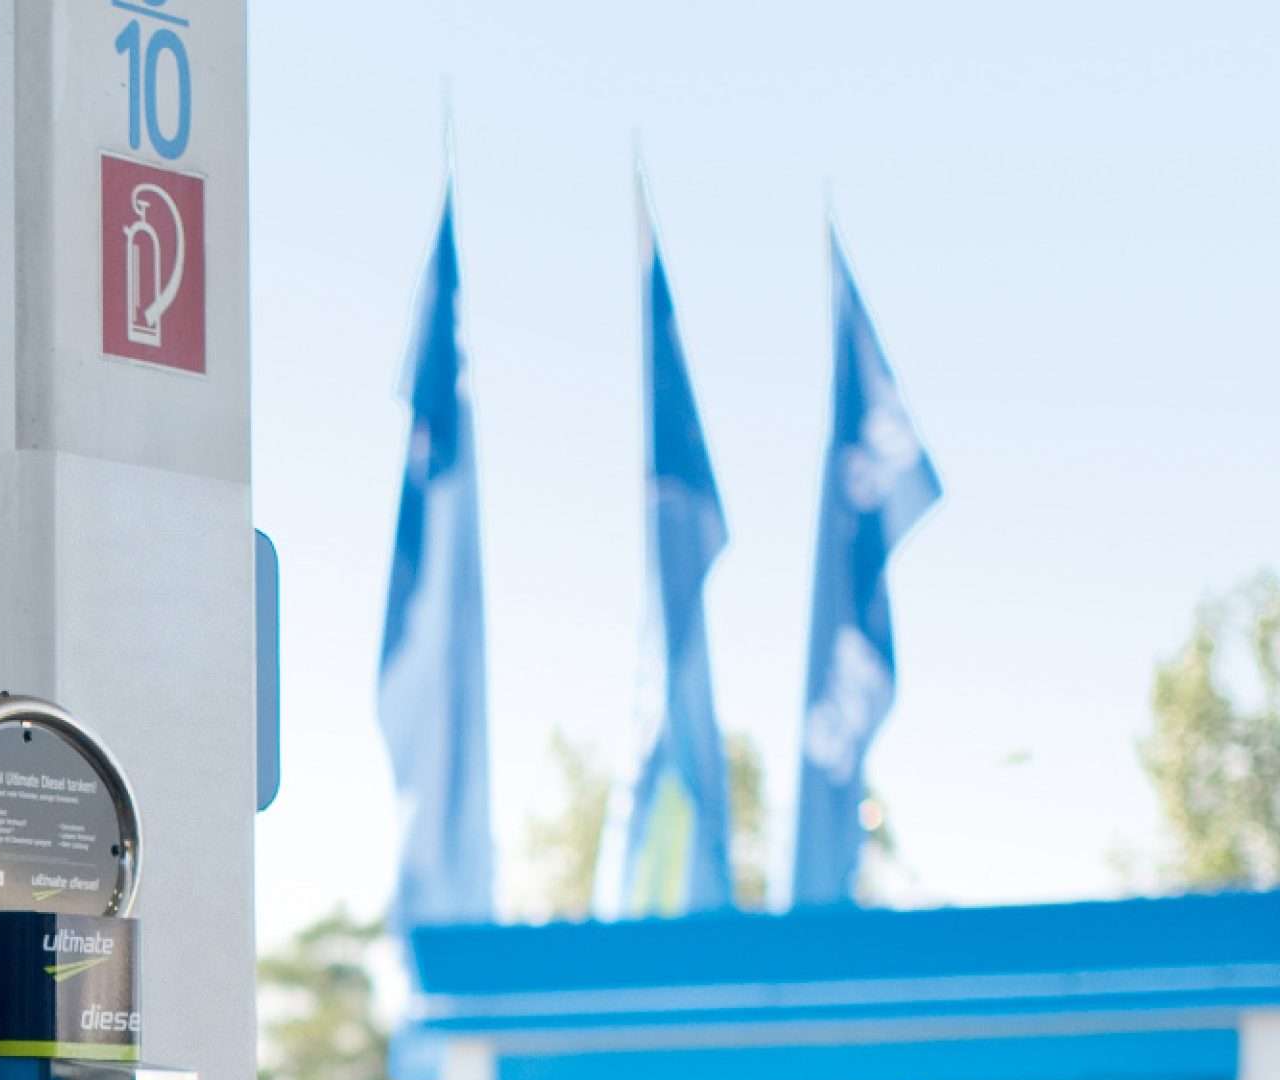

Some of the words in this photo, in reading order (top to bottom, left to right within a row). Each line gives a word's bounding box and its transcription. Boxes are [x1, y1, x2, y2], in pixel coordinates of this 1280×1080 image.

[115, 19, 192, 160] 10
[43, 928, 114, 955] ultimate
[81, 1004, 140, 1032] diese
